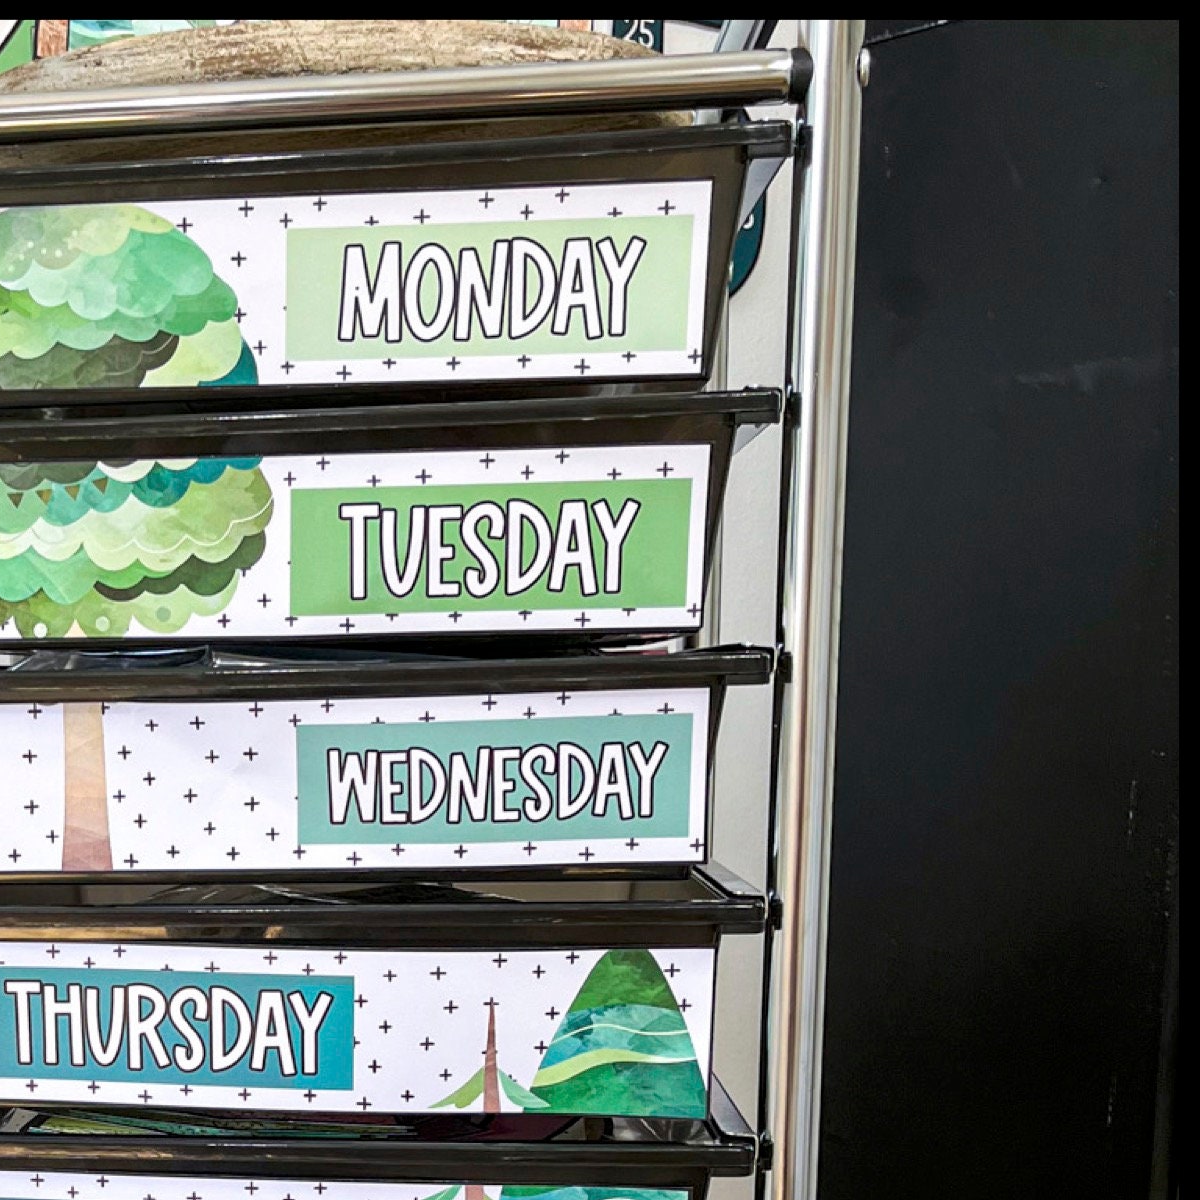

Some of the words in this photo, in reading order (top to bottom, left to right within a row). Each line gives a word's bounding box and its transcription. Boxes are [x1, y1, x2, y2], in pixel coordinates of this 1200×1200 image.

[624, 20, 655, 48] 25
[338, 236, 647, 343] MONDAY
[339, 498, 641, 600] TUESDAY
[327, 741, 669, 824] WEDNESDAY
[4, 980, 334, 1076] THURSDAY
